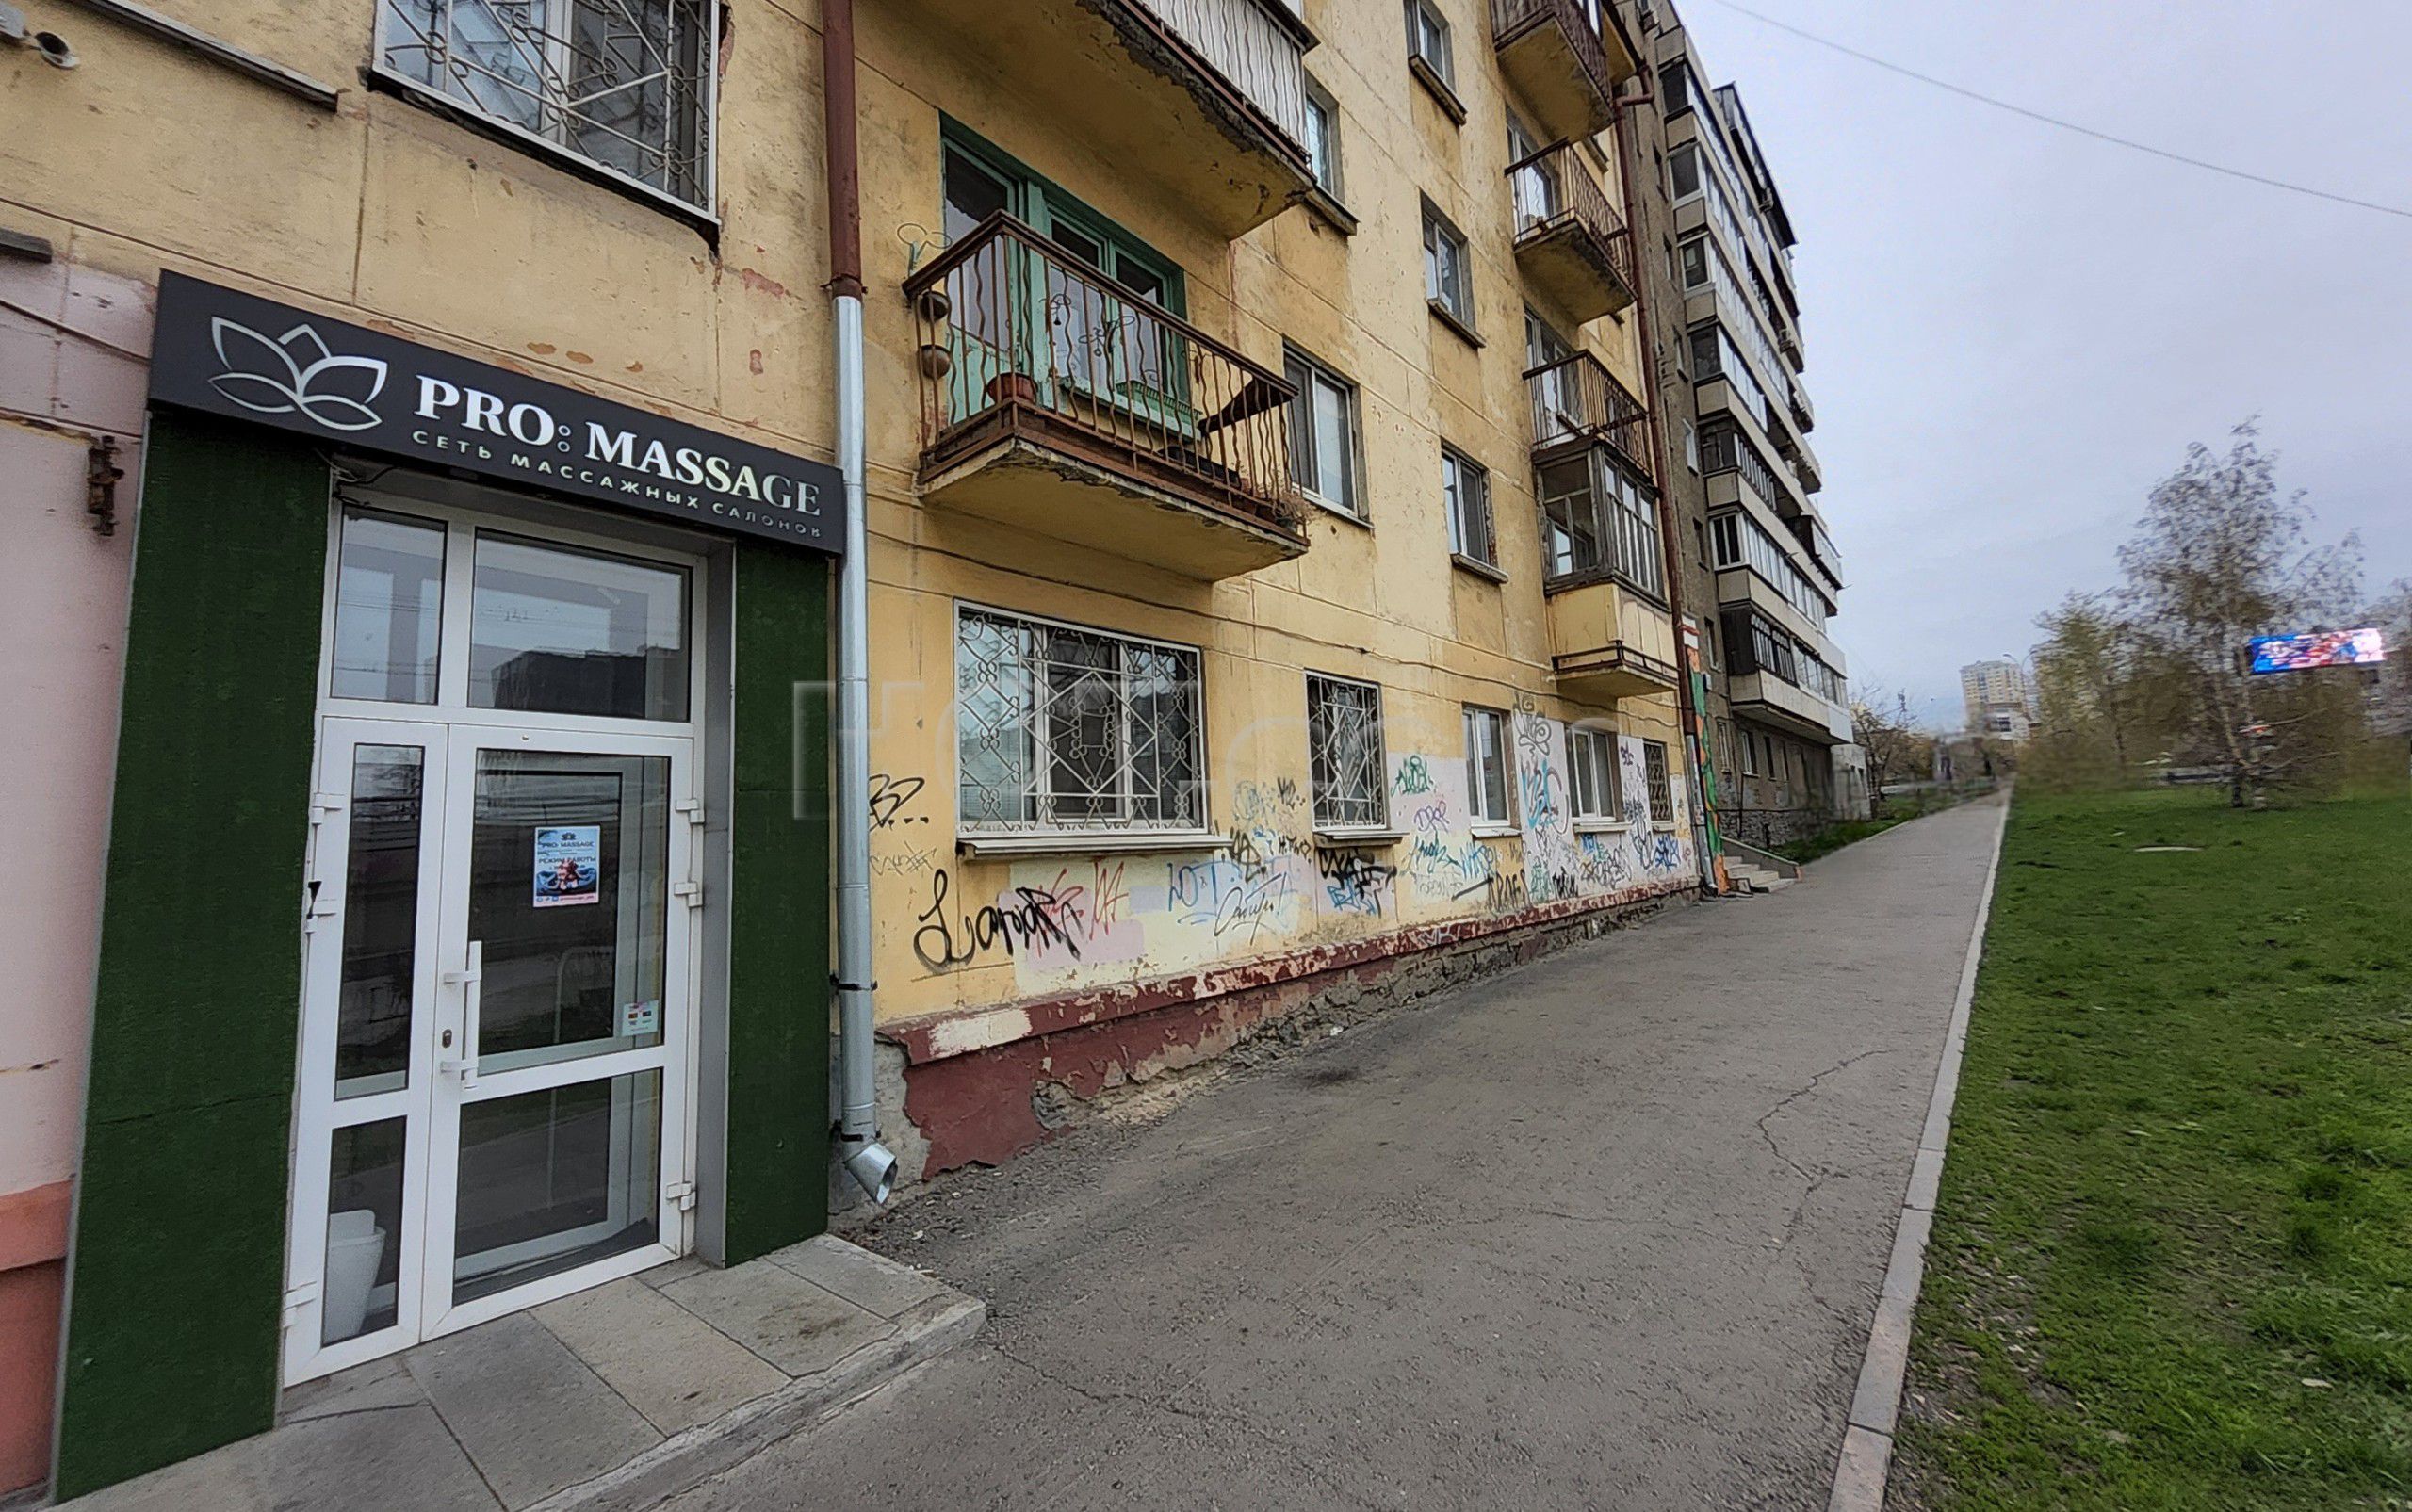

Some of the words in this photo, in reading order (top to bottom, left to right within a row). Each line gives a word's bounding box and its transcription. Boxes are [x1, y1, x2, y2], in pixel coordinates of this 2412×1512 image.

[412, 430, 493, 460] СЕТЬ
[510, 453, 699, 509] МАССАЖНЫХ
[712, 501, 822, 538] САЛОНОВ
[584, 421, 821, 517] MASSAGE
